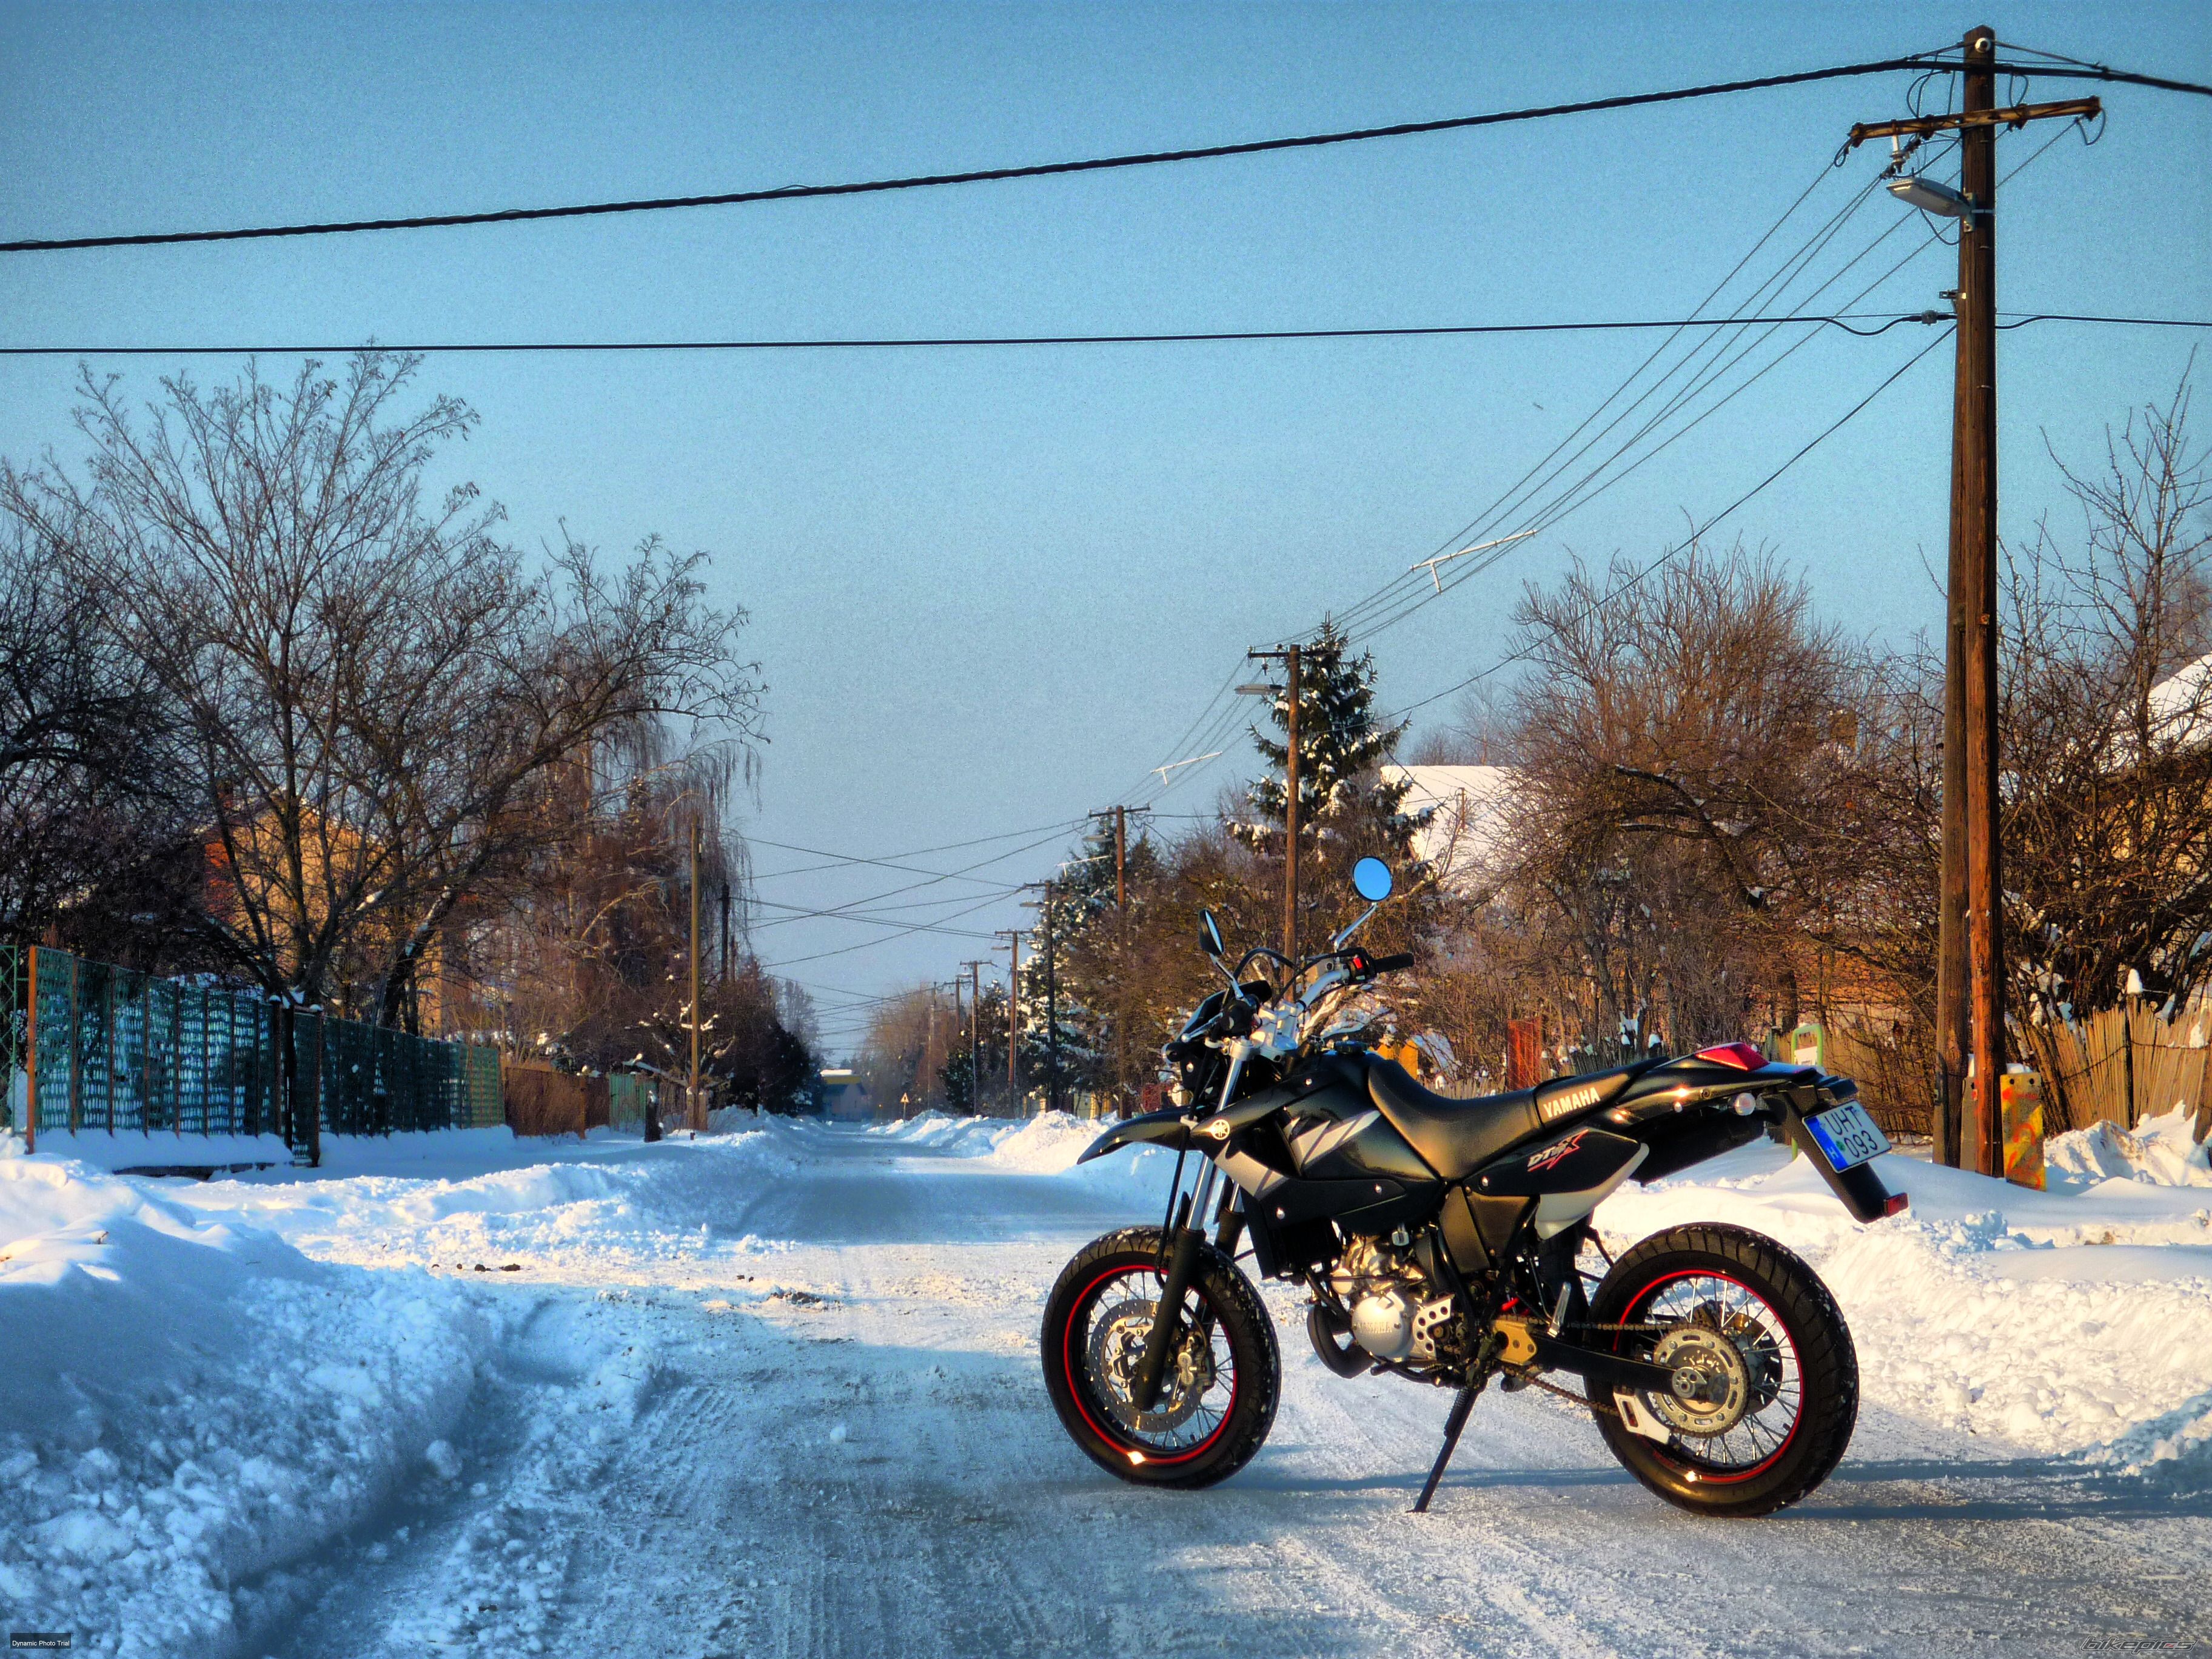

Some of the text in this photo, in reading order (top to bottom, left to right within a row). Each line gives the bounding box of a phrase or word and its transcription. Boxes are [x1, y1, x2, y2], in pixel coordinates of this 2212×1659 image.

[1543, 1087, 1601, 1118] YAMAHA
[1824, 1105, 1863, 1136] UHT
[1843, 1130, 1879, 1158] 093
[1357, 1321, 1393, 1334] YAMAHA
